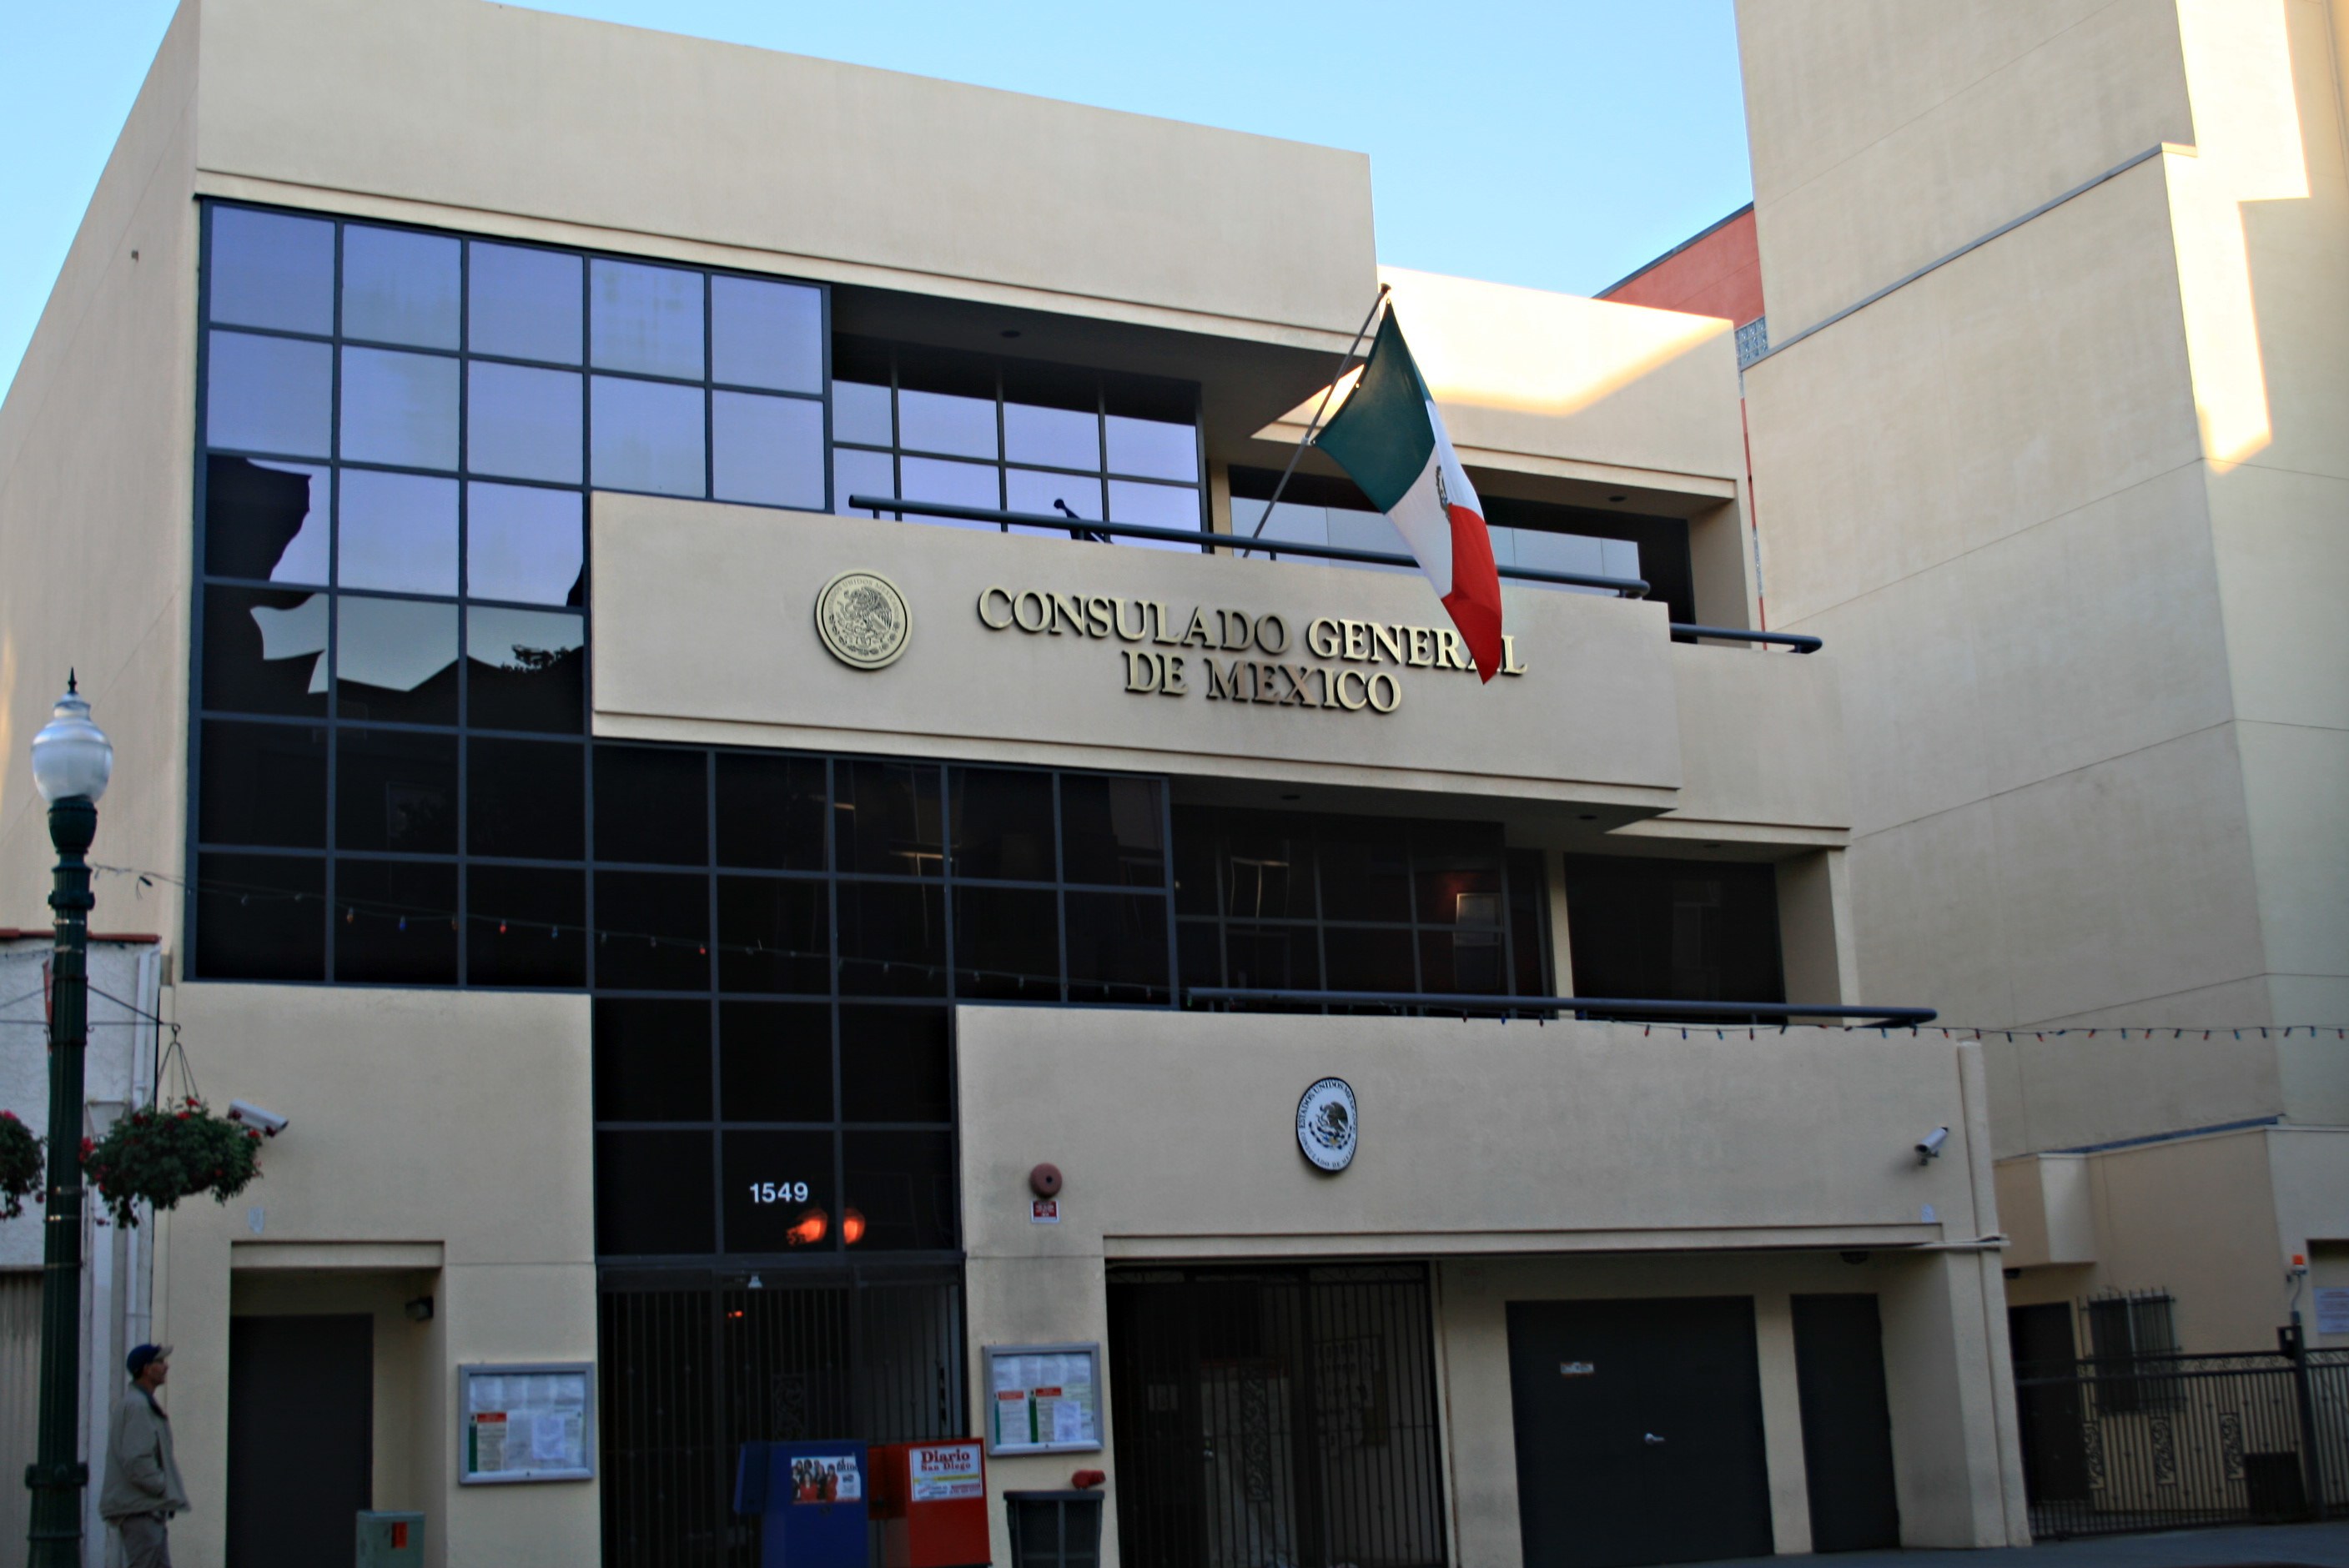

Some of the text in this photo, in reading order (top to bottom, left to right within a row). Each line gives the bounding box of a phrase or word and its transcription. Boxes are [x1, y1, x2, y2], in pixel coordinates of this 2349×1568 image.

[977, 585, 1528, 677] CONSULADO GENERL
[1122, 649, 1401, 714] DE MEXICO
[1298, 1092, 1315, 1128] ESTADOS
[1313, 1078, 1345, 1093] UNIDOS
[749, 1181, 809, 1204] 1549
[921, 1448, 970, 1463] Diario
[921, 1460, 971, 1472] San Diego
